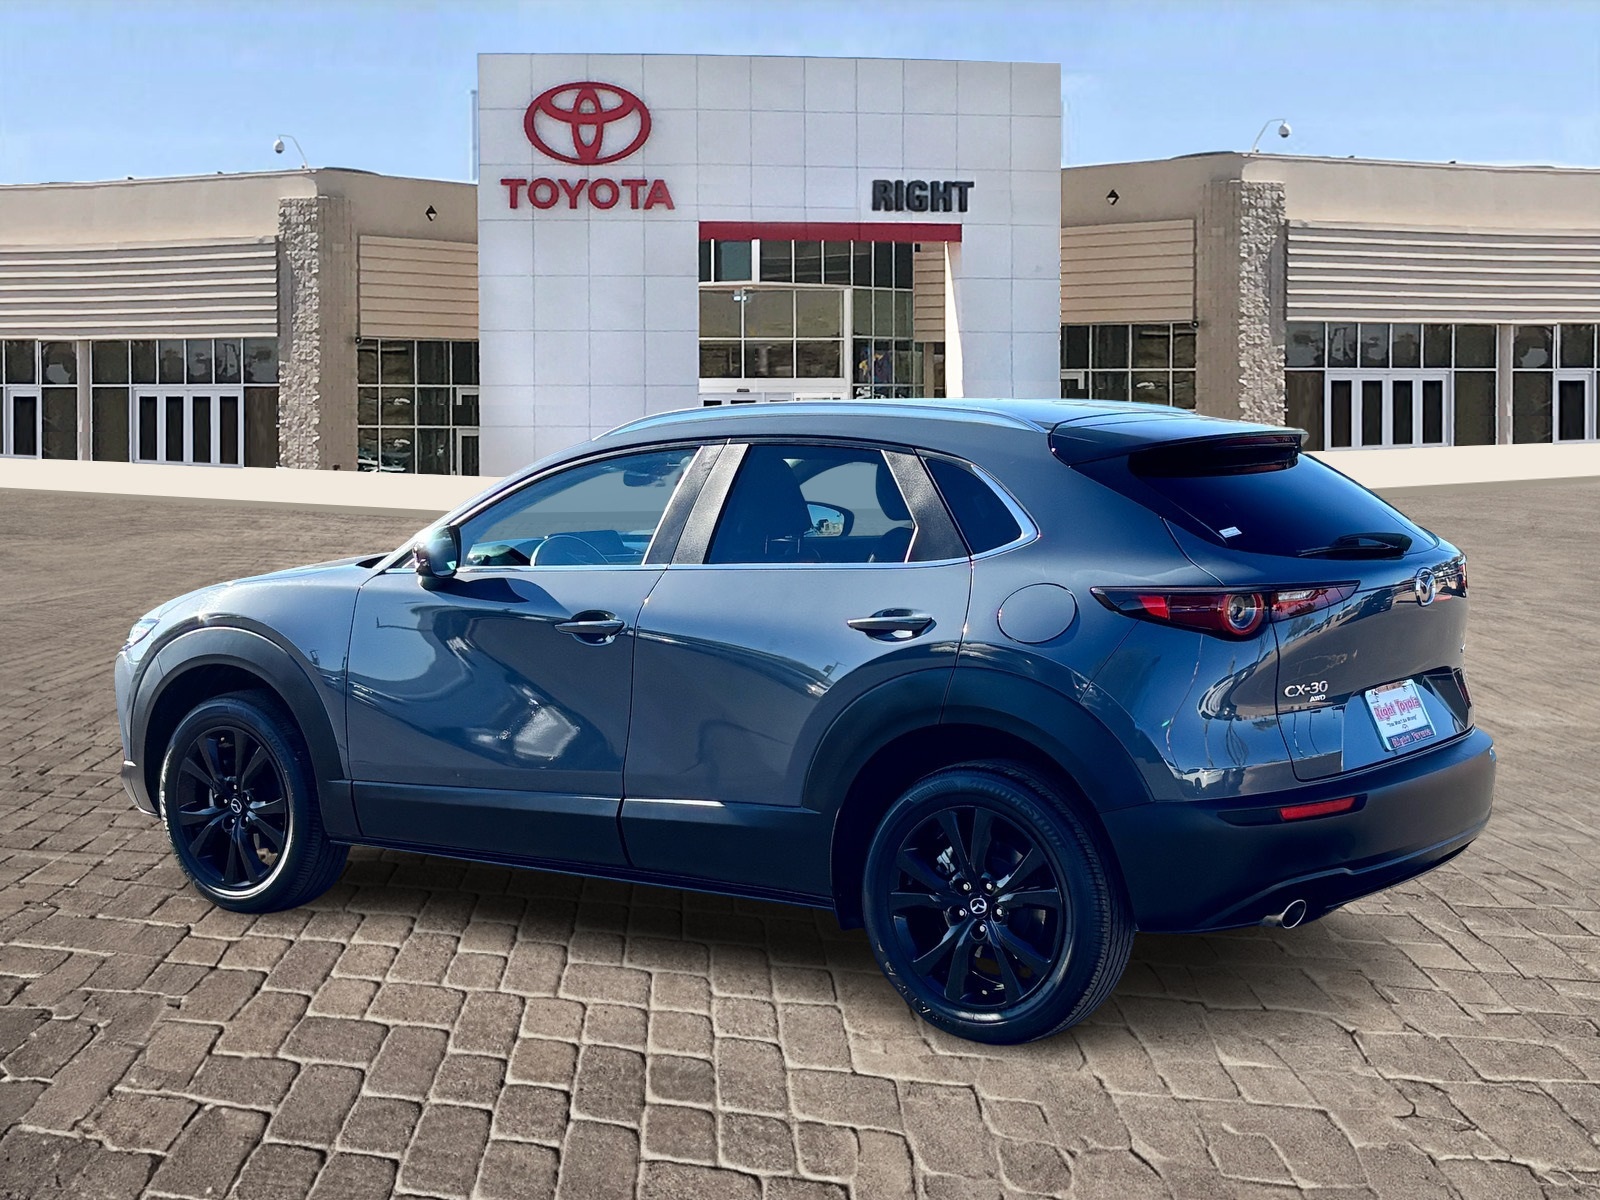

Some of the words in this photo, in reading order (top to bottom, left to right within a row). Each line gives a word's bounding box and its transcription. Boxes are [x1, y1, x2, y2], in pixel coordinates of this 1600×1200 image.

[500, 177, 675, 210] TOYOTA
[872, 179, 974, 212] RIGHT
[1284, 680, 1328, 697] CX-30
[1309, 694, 1326, 702] AWD
[1373, 702, 1397, 722] Right
